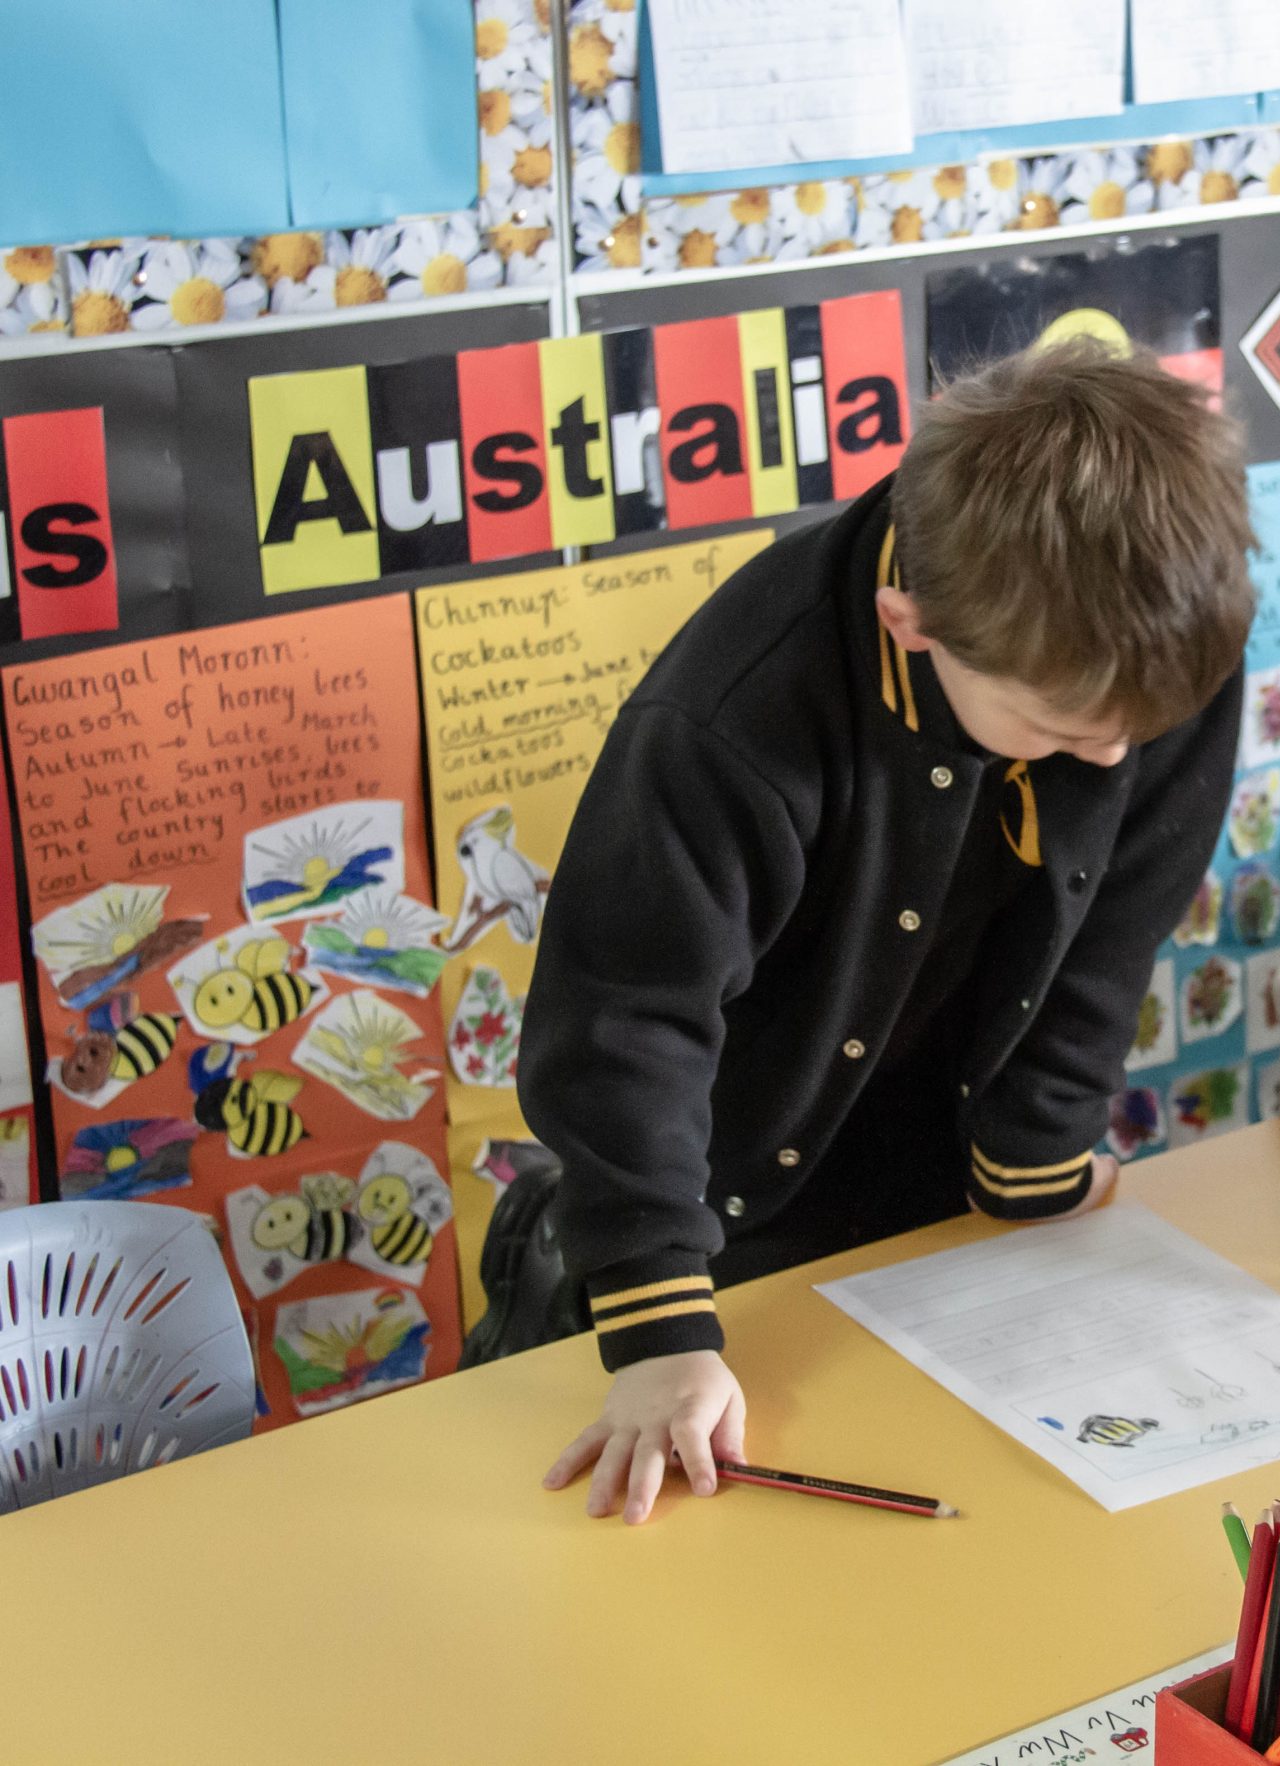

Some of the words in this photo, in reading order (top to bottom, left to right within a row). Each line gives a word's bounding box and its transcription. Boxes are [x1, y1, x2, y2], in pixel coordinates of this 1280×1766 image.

[260, 356, 903, 545] Australia
[0, 503, 108, 598] s
[582, 561, 673, 598] Season
[692, 545, 722, 587] of
[430, 629, 582, 676] Cockatoos
[16, 711, 140, 747] Season
[164, 685, 194, 728] of
[217, 681, 296, 722] honey
[314, 667, 369, 696] bees
[437, 678, 531, 711] Winter
[438, 713, 490, 747] Cold
[502, 692, 600, 728] morning
[24, 740, 150, 781] Autumn
[206, 724, 270, 749] Late
[301, 704, 377, 732] March
[26, 790, 54, 810] to
[81, 776, 148, 802] June
[326, 733, 381, 756] bees
[443, 752, 592, 804] wildflowers
[28, 813, 92, 840] and
[120, 778, 246, 823] flocking
[267, 762, 347, 789] birds
[33, 838, 90, 863] The
[116, 811, 224, 846] country
[260, 788, 337, 816] starts
[356, 780, 381, 798] to
[37, 863, 96, 893] cool
[129, 842, 211, 869] down
